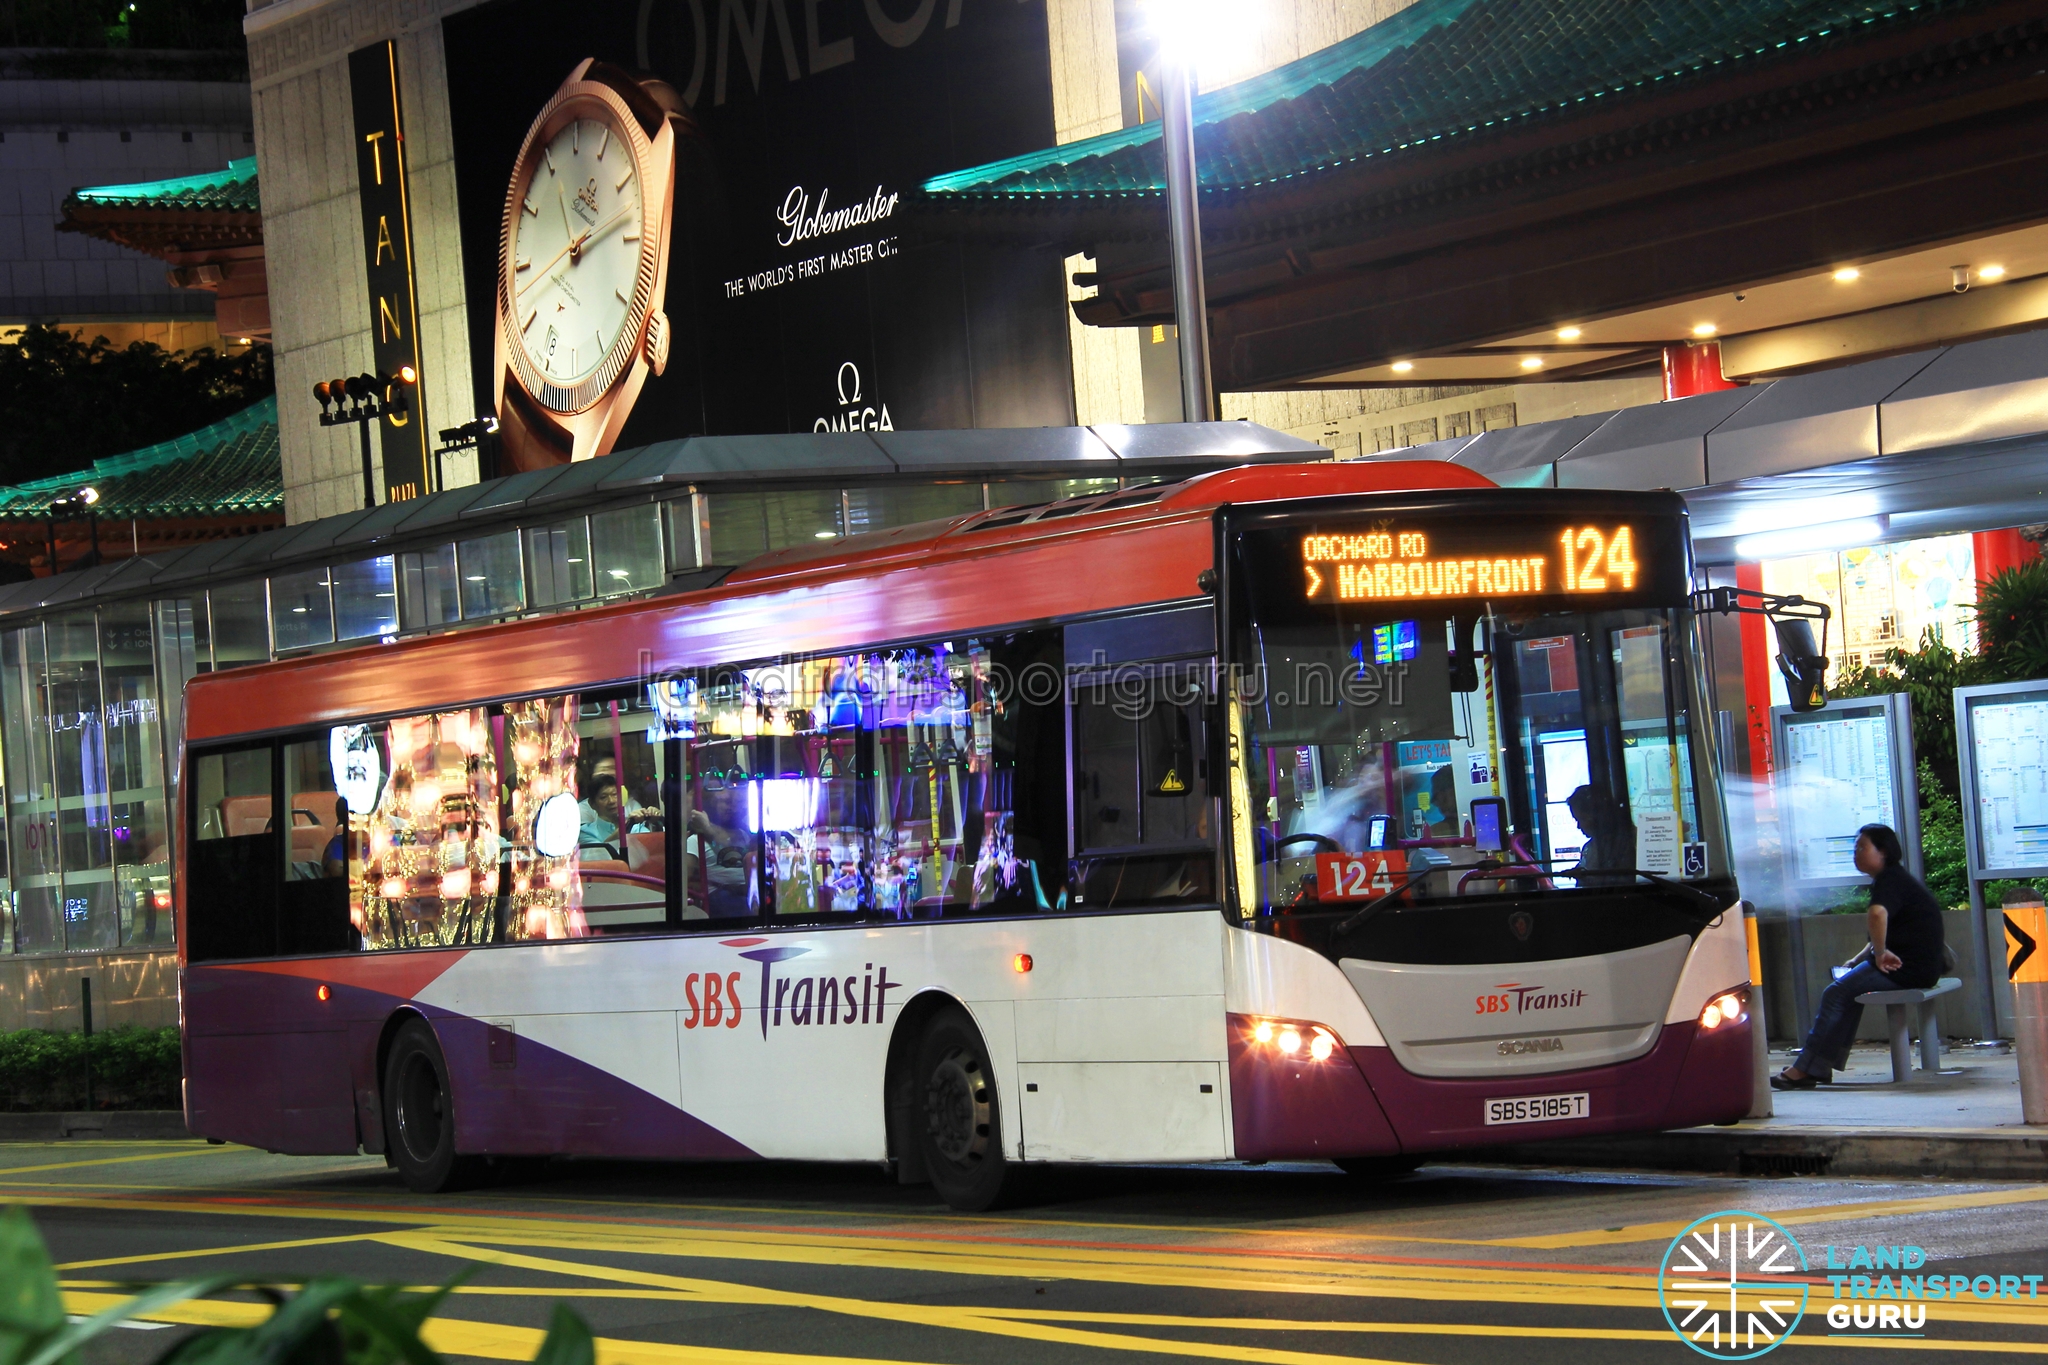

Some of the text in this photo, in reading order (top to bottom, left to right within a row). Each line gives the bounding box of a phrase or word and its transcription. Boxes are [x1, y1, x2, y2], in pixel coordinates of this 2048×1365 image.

[776, 184, 899, 247] Globemaster
[724, 278, 745, 299] THE
[747, 263, 795, 293] WORLD'S
[798, 255, 826, 279] FIRST
[829, 242, 874, 272] MASTER
[1303, 532, 1426, 561] ORCHARD RD
[1560, 525, 1639, 591] 124
[1337, 557, 1545, 599] HARBOURFRONT
[1330, 859, 1394, 897] 124
[684, 946, 904, 1043] SBS Transit
[1475, 985, 1589, 1016] SBS Transit
[1496, 1037, 1565, 1056] SCANIA
